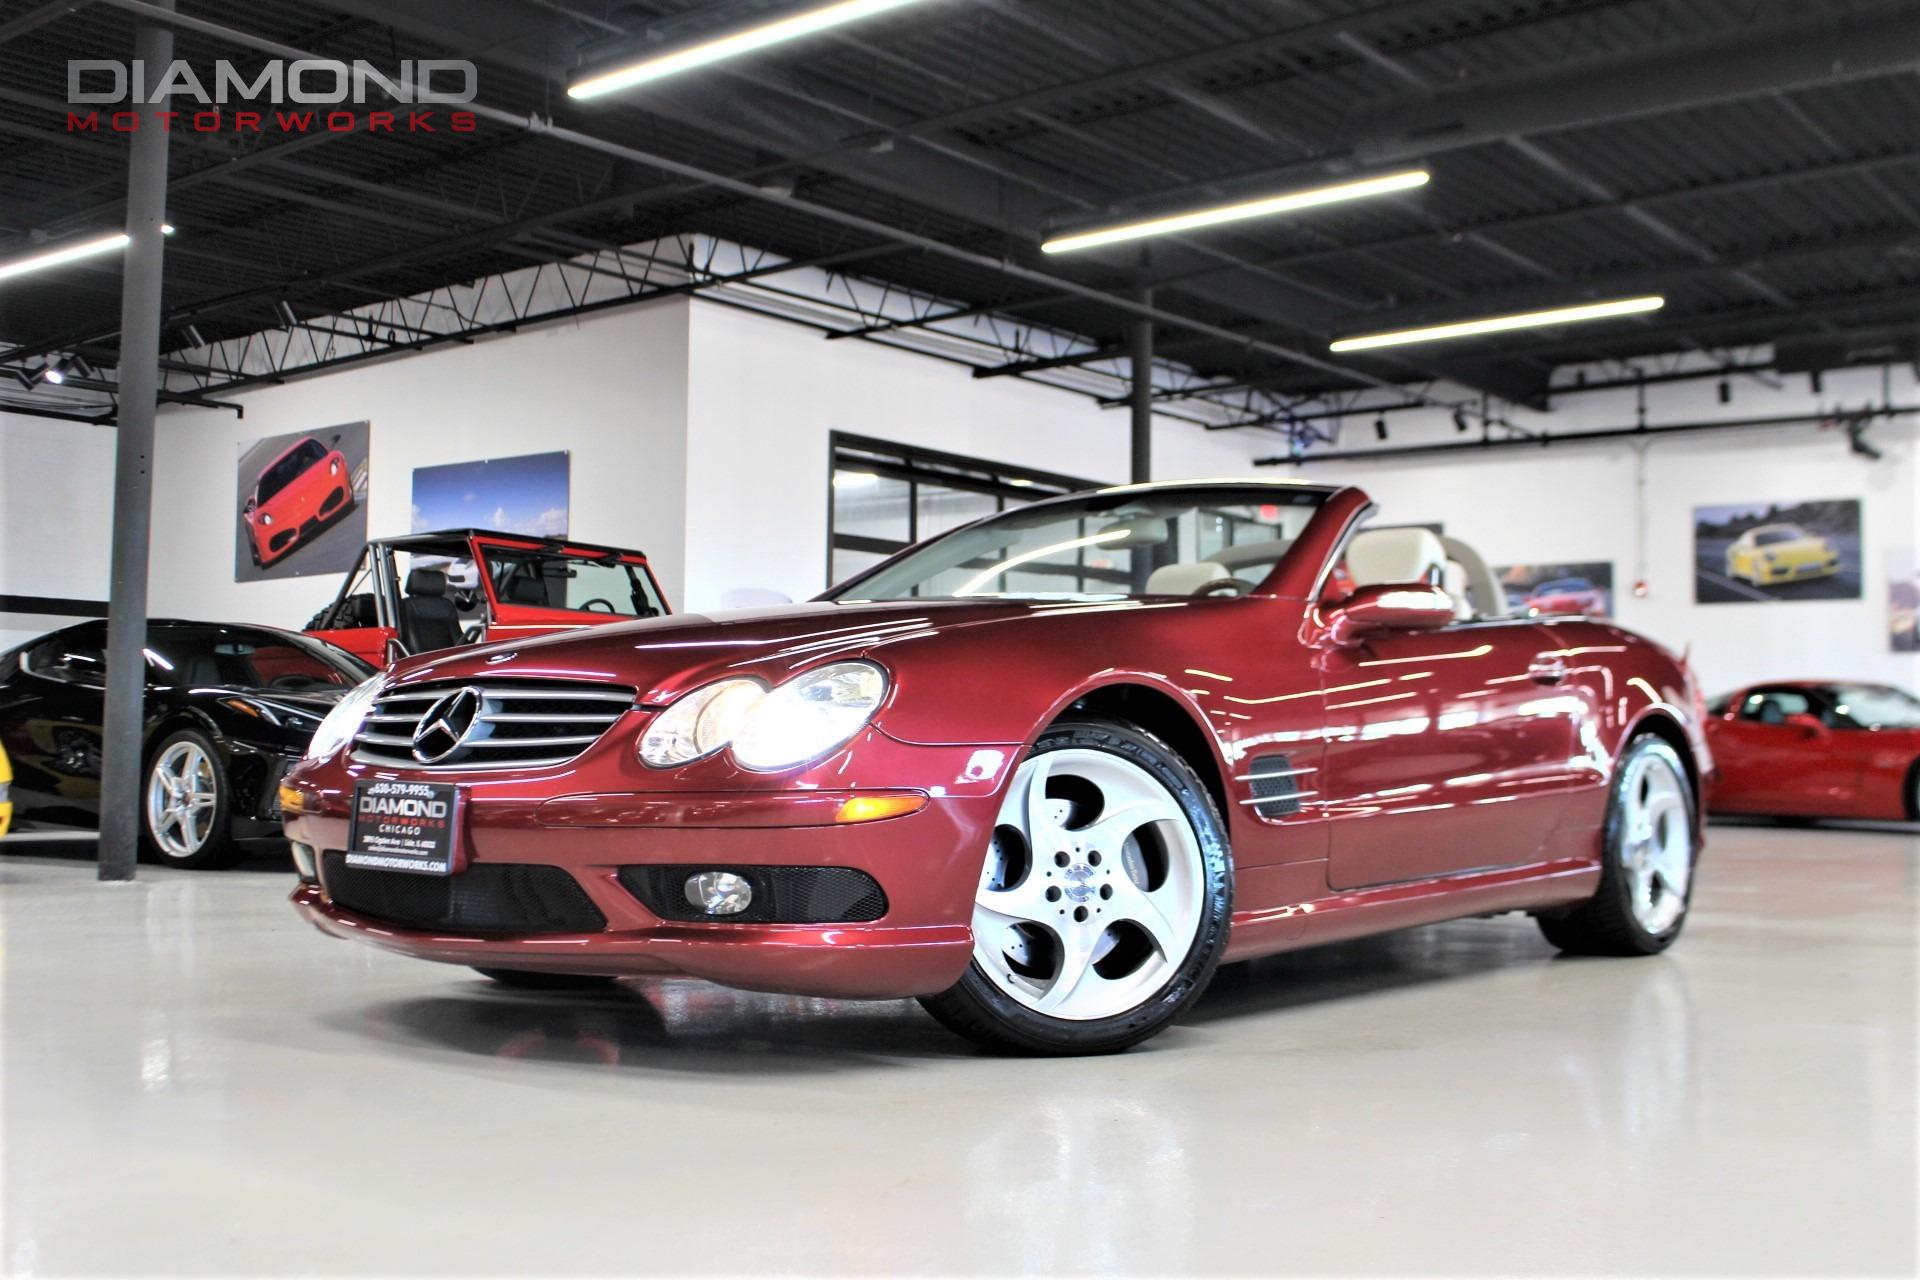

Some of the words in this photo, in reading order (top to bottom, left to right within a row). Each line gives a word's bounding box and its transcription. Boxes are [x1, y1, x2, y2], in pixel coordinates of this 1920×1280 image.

[359, 796, 447, 818] DIAMOND
[358, 815, 446, 829] MOTORWORKS
[379, 824, 421, 835] CHICAGO
[345, 854, 447, 872] DIAMONDMOTORWORKS.COM
